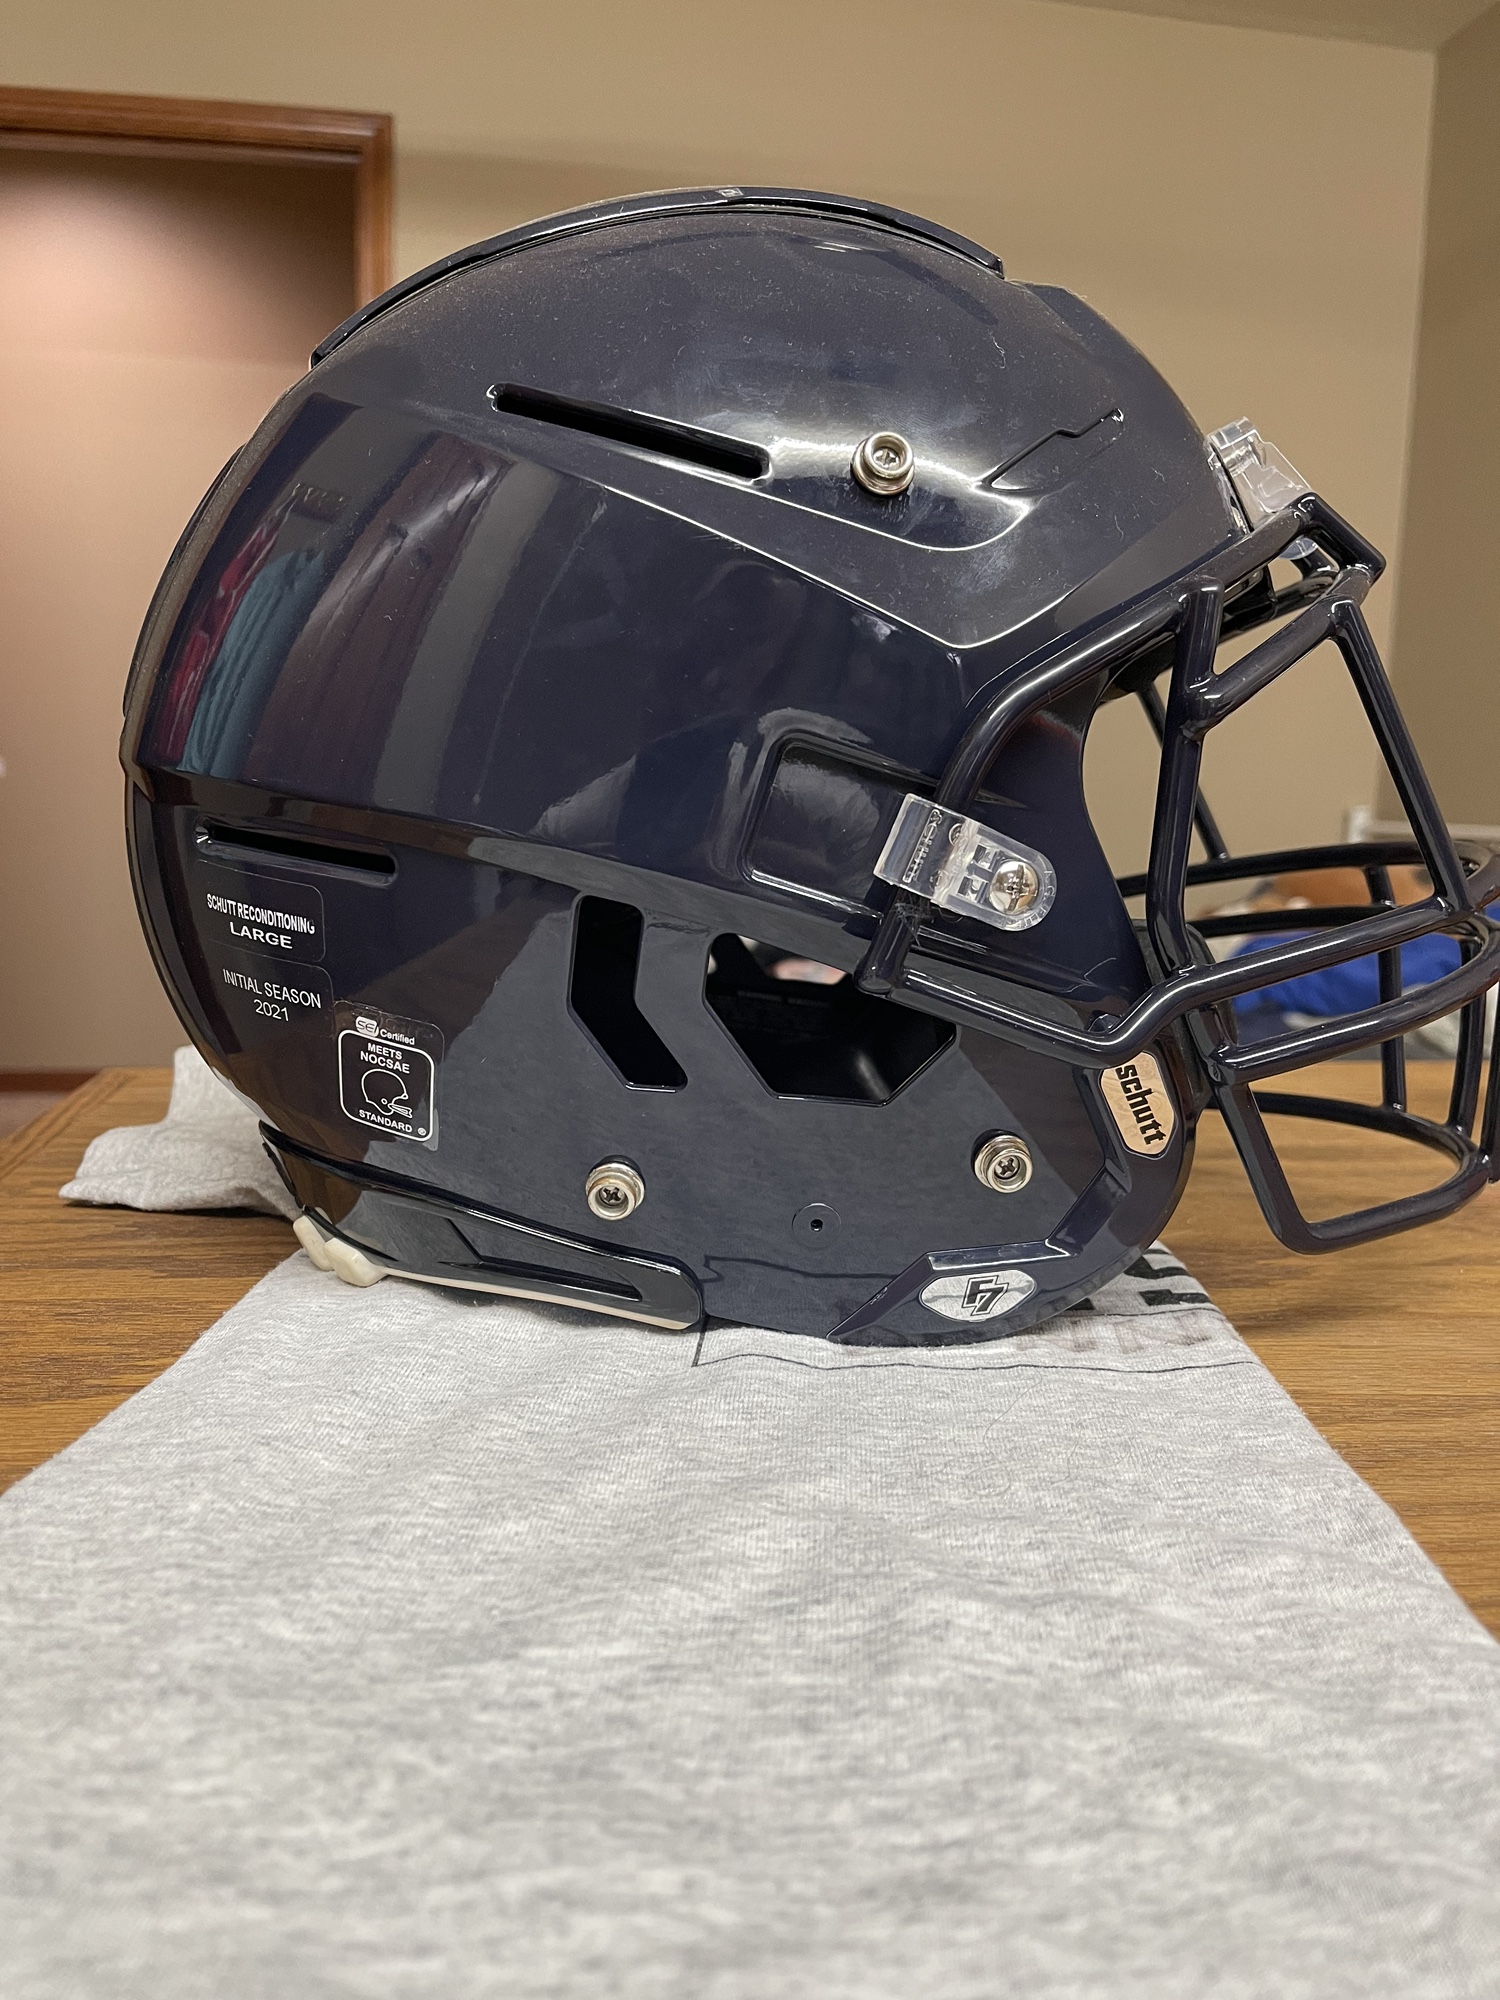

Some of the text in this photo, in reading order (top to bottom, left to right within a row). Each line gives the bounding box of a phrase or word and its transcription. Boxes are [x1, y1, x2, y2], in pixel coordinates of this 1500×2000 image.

[206, 893, 316, 934] SCHUTT RECONDITIONING
[229, 921, 293, 949] LARGE
[222, 968, 322, 1009] INITIAL SEASON
[253, 999, 289, 1021] 2021
[380, 1028, 415, 1046] Certified
[360, 1050, 410, 1074] NOCSAE
[367, 1042, 403, 1060] MEETS
[1114, 1064, 1167, 1145] schutt
[359, 1109, 413, 1133] STANDARD
